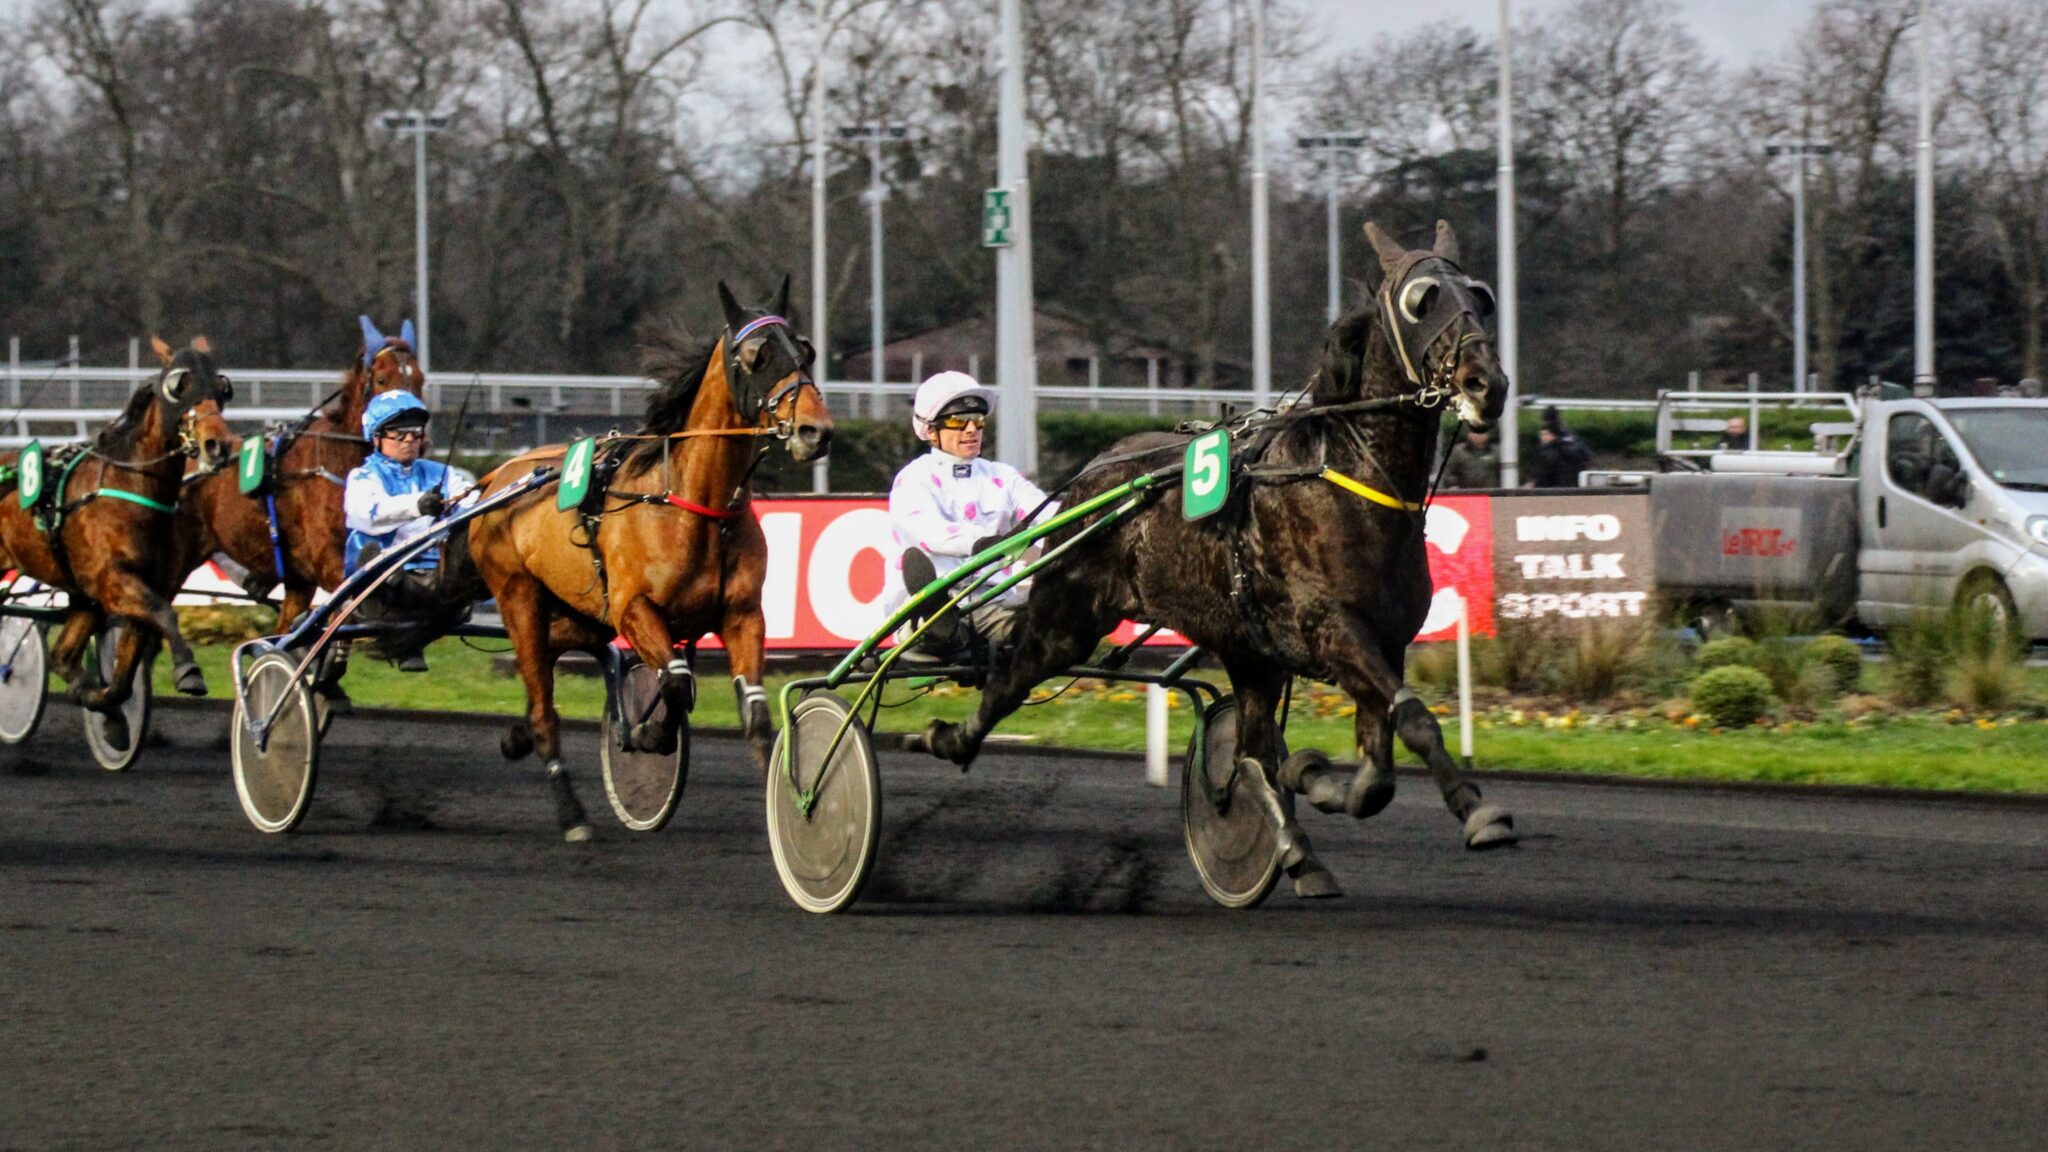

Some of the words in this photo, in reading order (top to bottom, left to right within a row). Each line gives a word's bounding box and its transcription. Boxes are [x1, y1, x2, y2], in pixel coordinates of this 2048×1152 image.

[22, 451, 40, 497] 8
[243, 436, 260, 478] 7
[563, 441, 588, 489] 4
[1191, 433, 1221, 497] 5
[1516, 514, 1621, 542] INFO
[1513, 553, 1626, 579] TALK
[1496, 591, 1648, 618] SPORT
